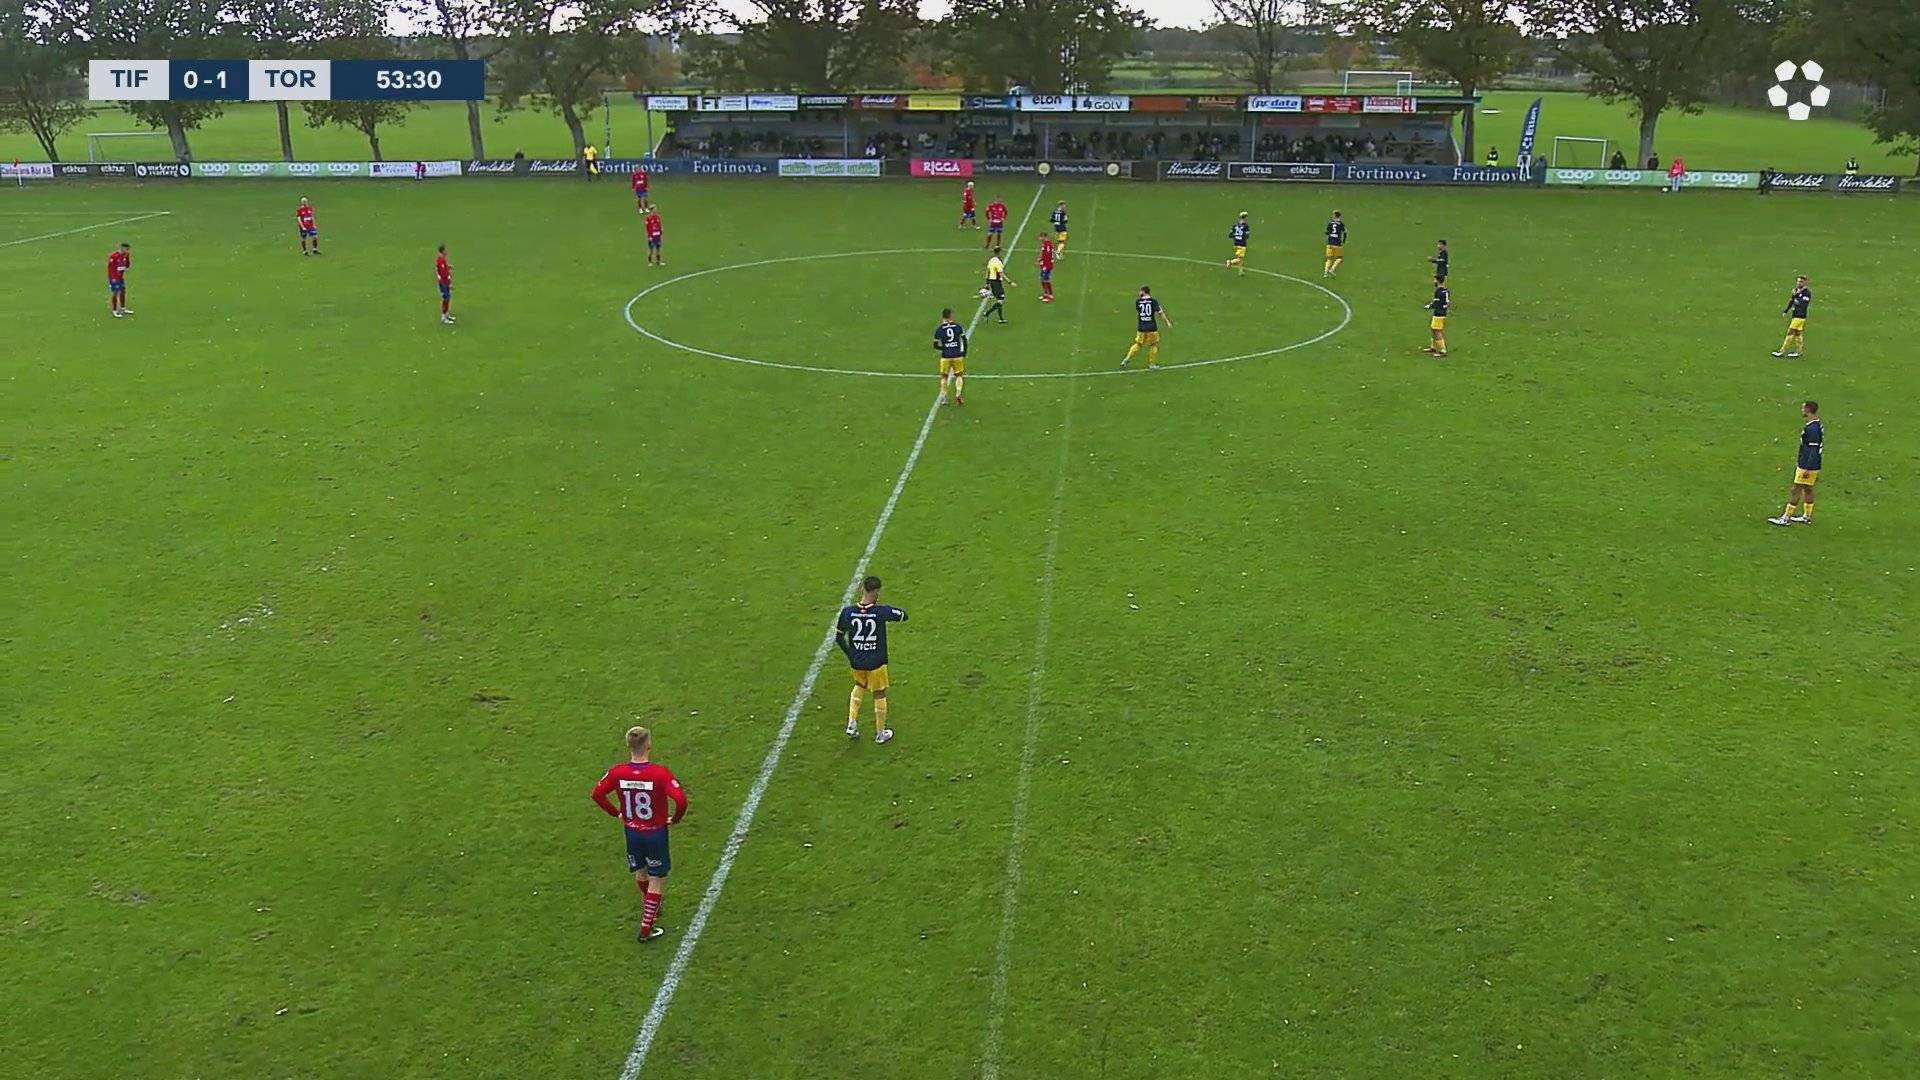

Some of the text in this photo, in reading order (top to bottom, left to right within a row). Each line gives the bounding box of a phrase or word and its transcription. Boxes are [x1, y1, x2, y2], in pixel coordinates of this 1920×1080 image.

[200, 163, 230, 174] coop
[238, 163, 269, 173] coop
[288, 163, 319, 173] coop
[327, 162, 359, 173] coop
[596, 161, 664, 173] Fortinova
[693, 160, 762, 173] Fortinova
[1347, 166, 1421, 180] Fortinova
[1556, 170, 1594, 180] coop
[1604, 170, 1640, 181] coop
[1711, 173, 1748, 185] coop
[1139, 303, 1152, 316] 20
[946, 328, 955, 342] 9
[851, 618, 877, 641] 22
[623, 790, 653, 820] 18
